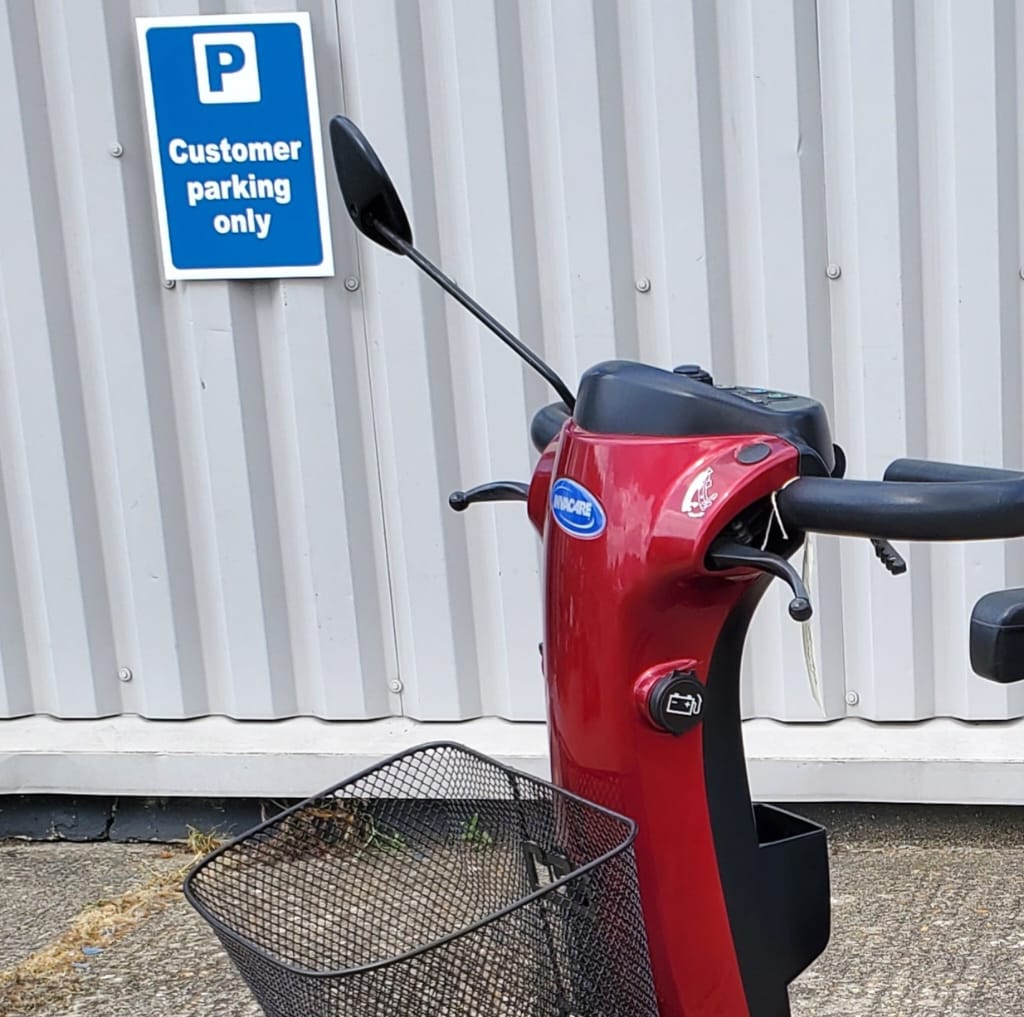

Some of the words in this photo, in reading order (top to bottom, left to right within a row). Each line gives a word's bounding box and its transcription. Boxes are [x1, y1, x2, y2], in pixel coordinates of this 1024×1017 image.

[204, 43, 245, 92] P
[169, 137, 302, 164] Customer
[187, 174, 292, 207] parking
[213, 208, 271, 239] only
